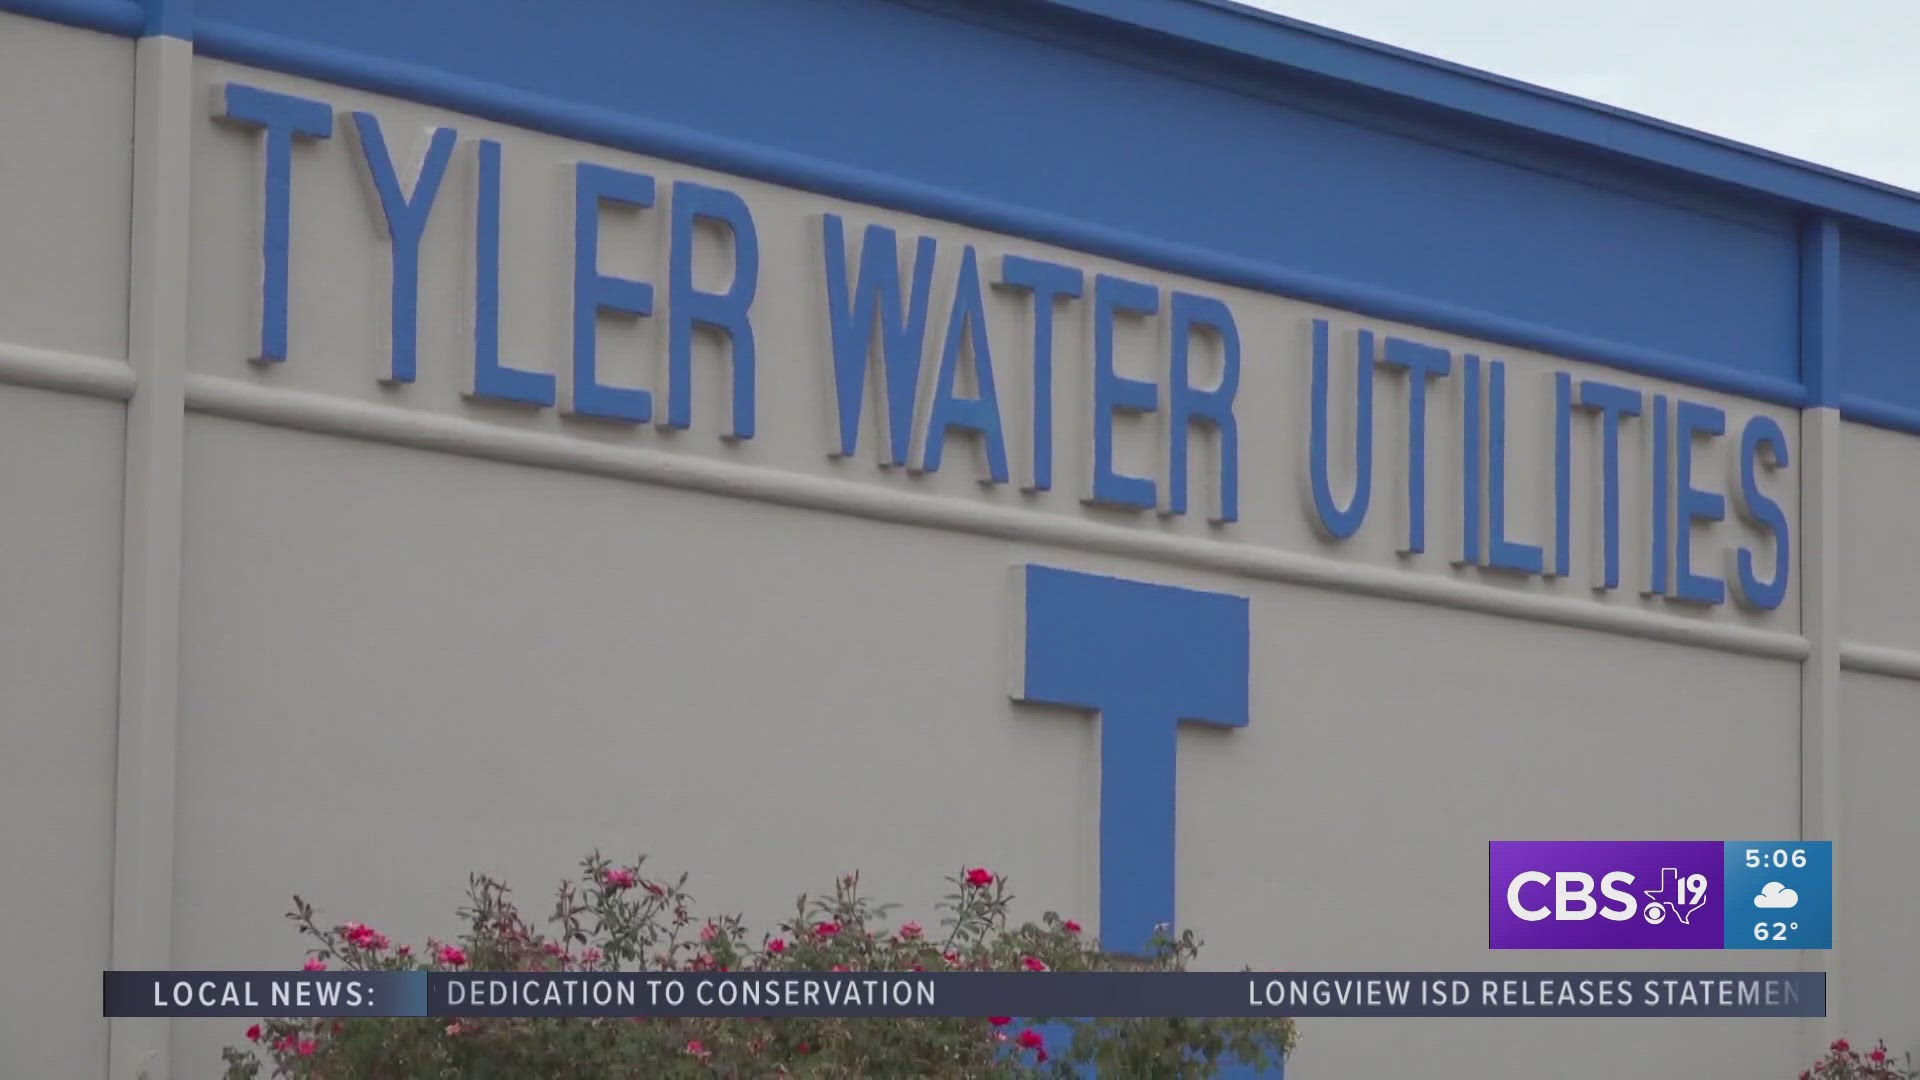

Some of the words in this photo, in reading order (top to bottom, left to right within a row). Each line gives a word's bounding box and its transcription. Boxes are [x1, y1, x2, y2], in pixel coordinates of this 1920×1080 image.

[225, 83, 760, 440] TYLER
[823, 214, 1242, 525] WATER
[1310, 319, 1791, 612] UTILITIES
